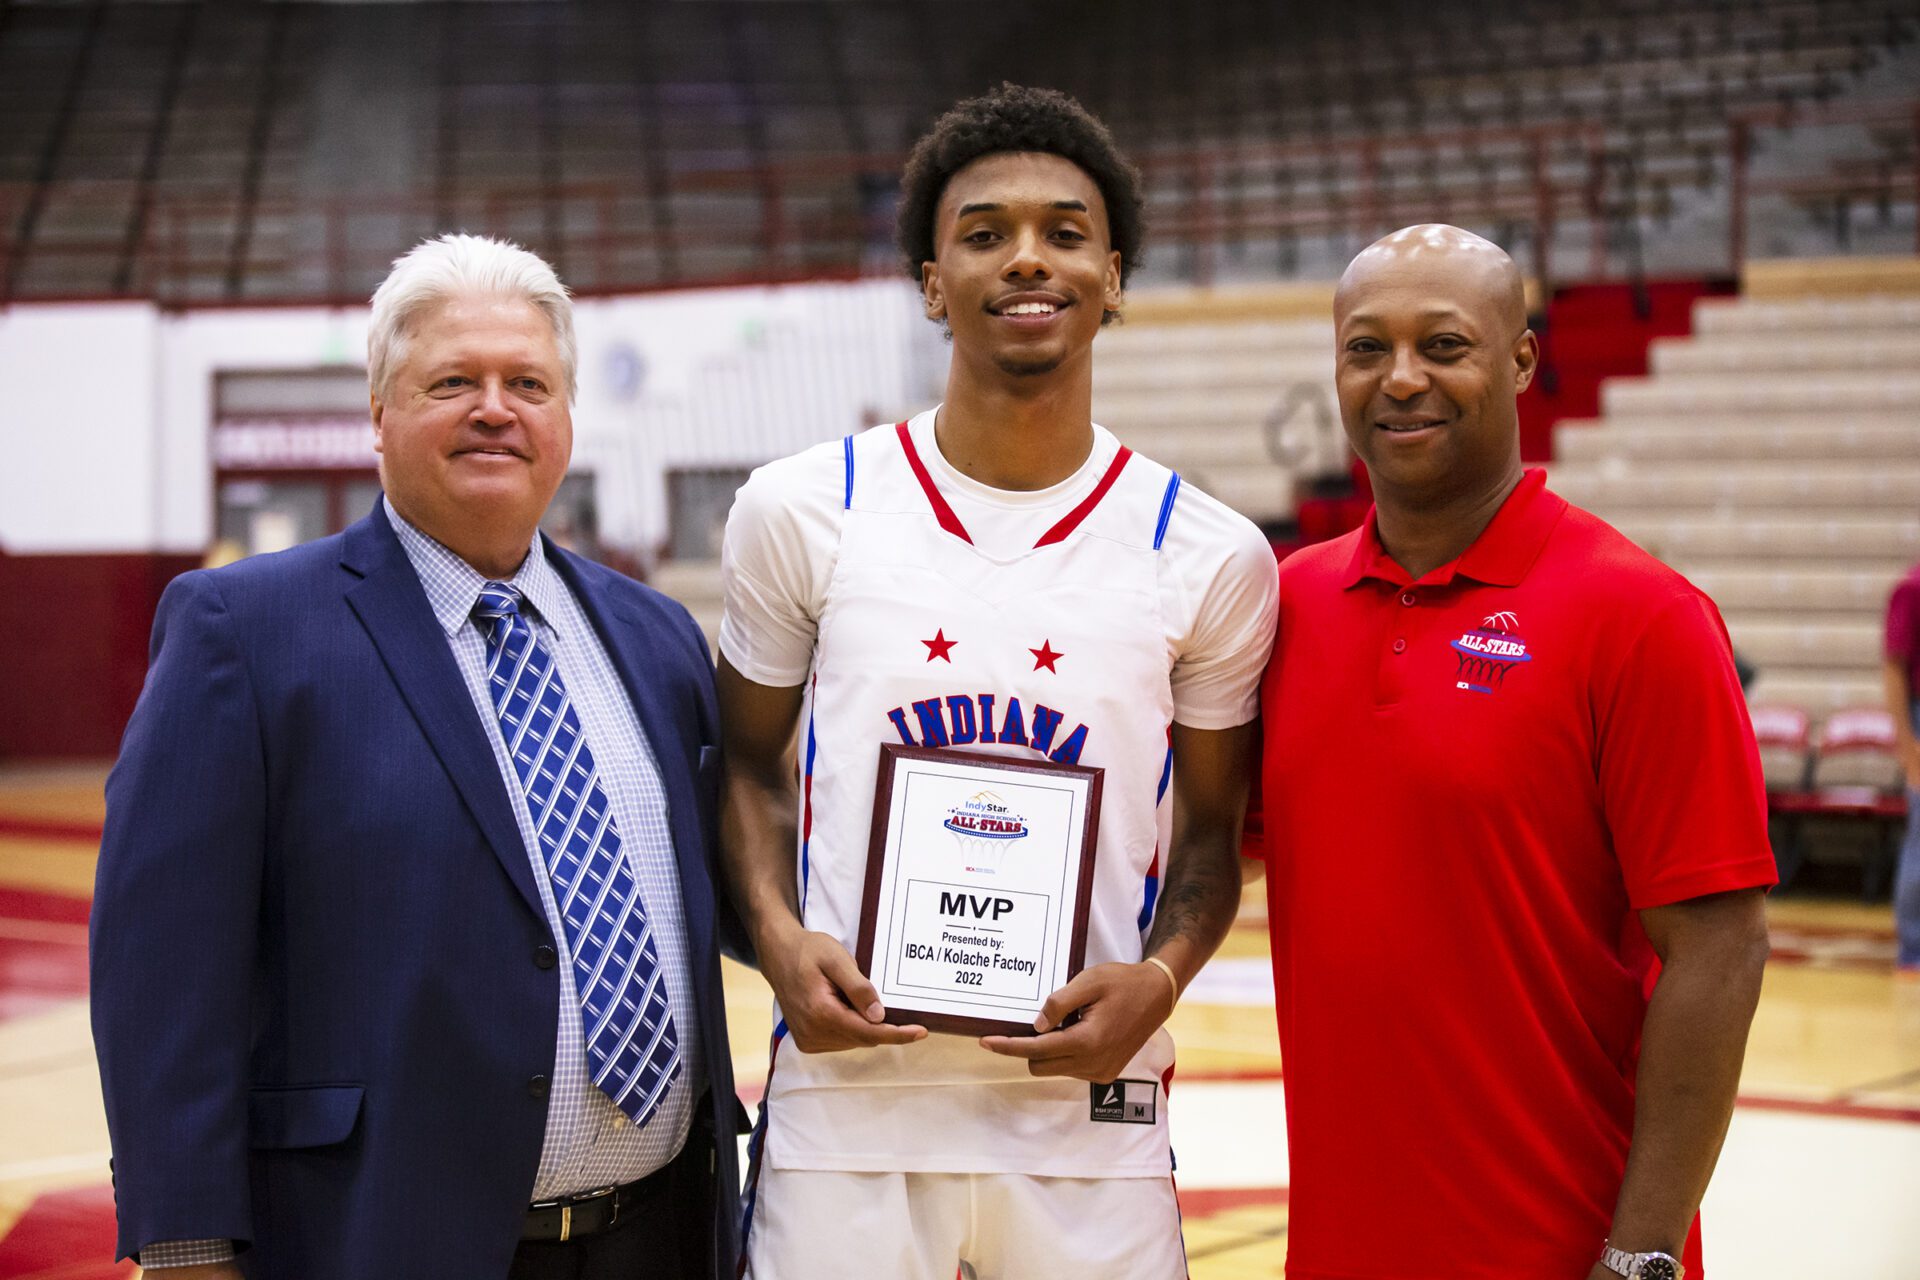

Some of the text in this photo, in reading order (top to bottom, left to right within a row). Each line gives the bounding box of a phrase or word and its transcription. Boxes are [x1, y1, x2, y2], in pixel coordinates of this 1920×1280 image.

[1458, 634, 1526, 657] ALL-STARS
[887, 694, 1090, 765] INDIANA
[956, 810, 980, 818] INDIANA
[996, 814, 1018, 822] SCHOOL
[939, 891, 1014, 921] MVP
[942, 931, 1004, 951] Presented by:
[905, 943, 1037, 976] IBCA / Kolache Factory
[955, 970, 983, 986] 2022
[1134, 1105, 1145, 1117] M
